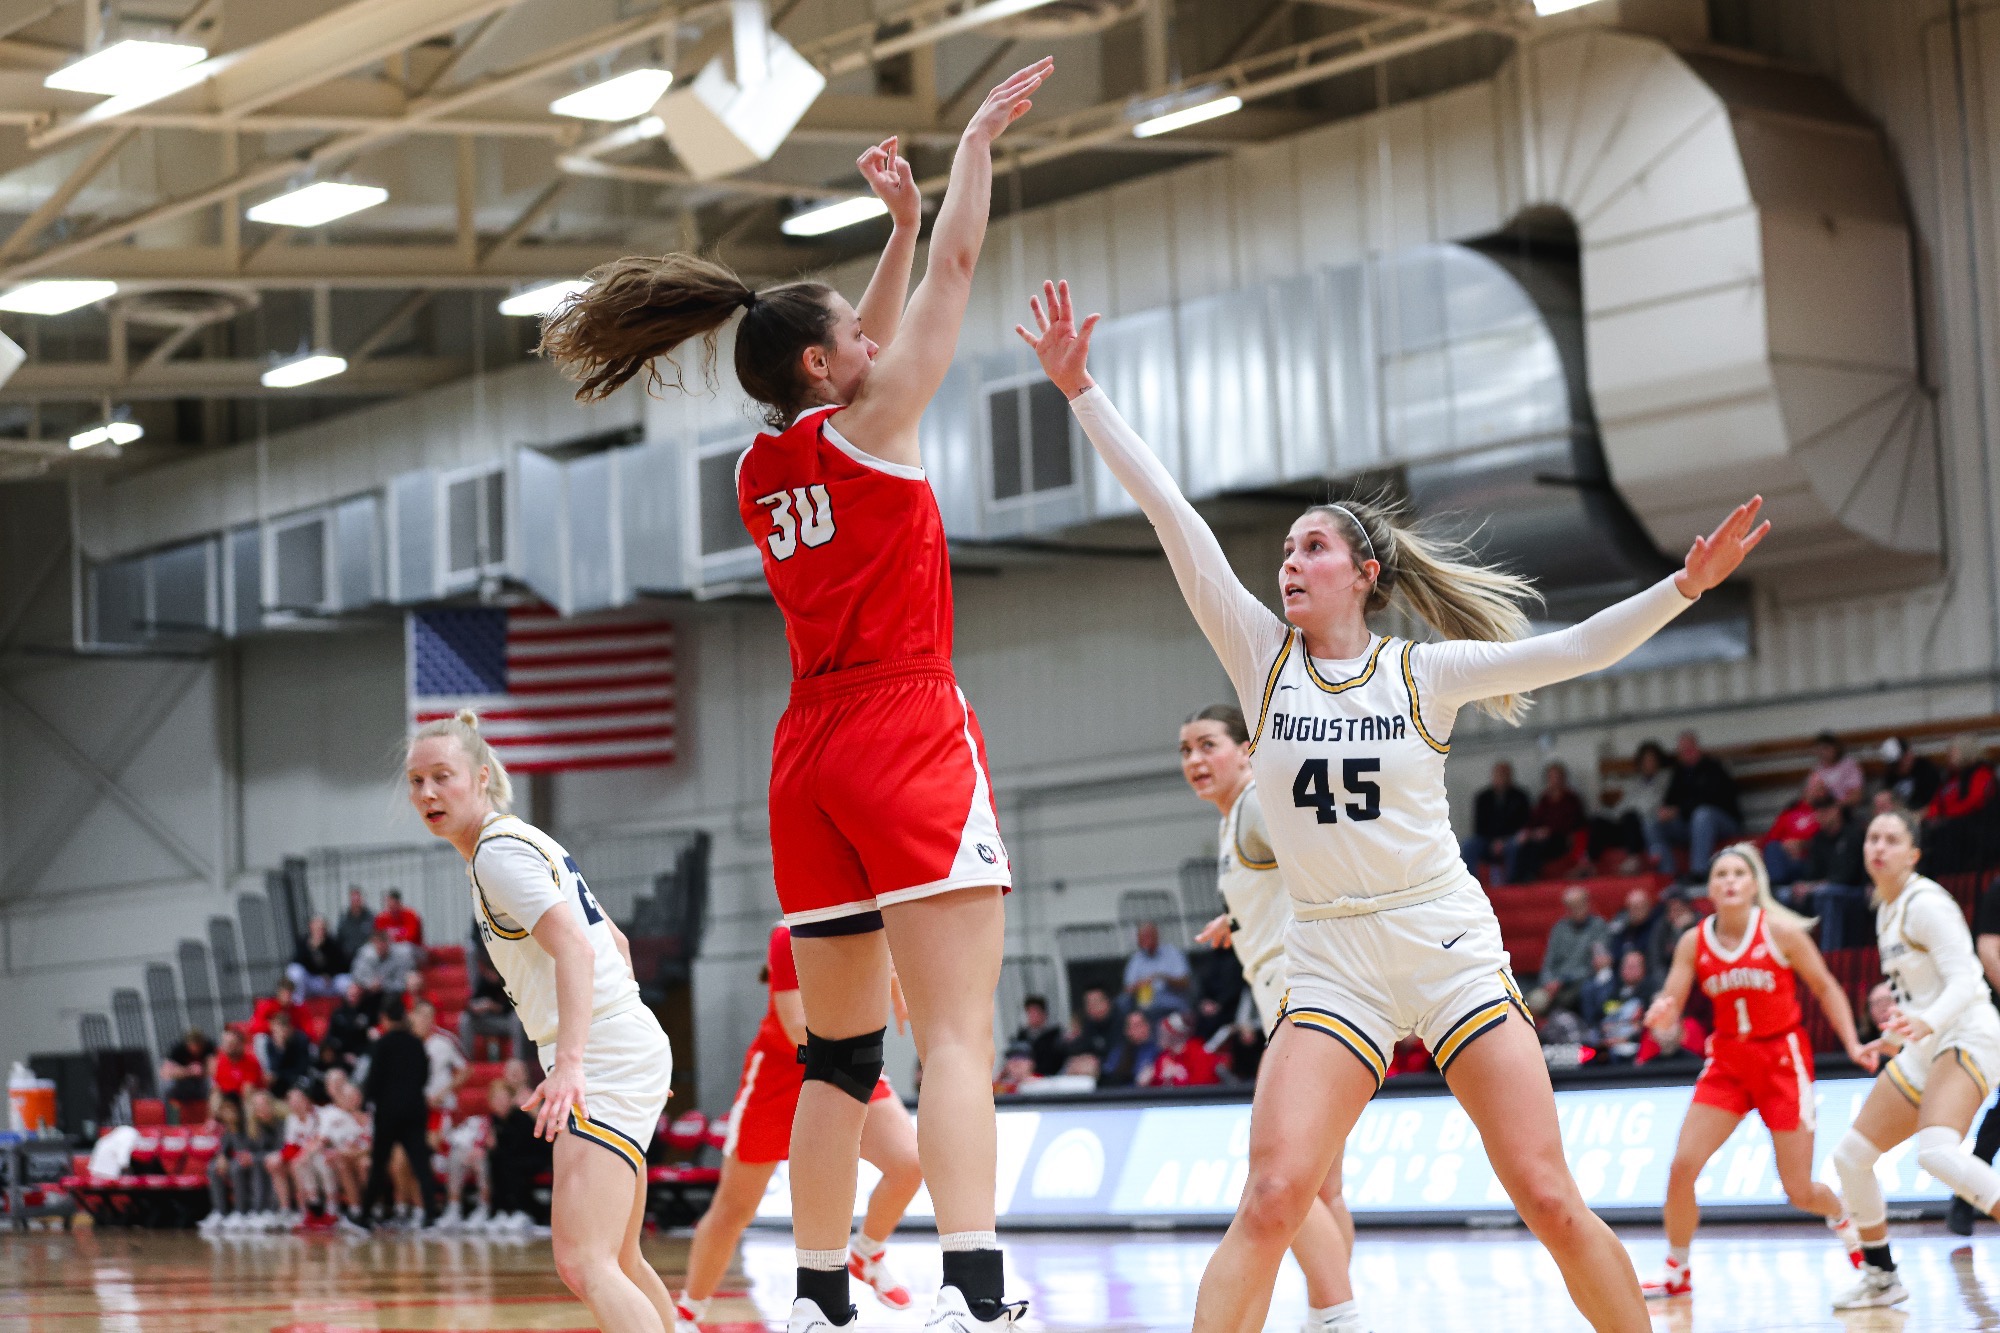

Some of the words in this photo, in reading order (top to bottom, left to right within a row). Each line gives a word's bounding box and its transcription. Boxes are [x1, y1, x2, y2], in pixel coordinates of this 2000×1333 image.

[1272, 713, 1406, 742] AUGUSTANA
[1293, 757, 1381, 824] 45
[1734, 998, 1752, 1034] 1
[1437, 1100, 1656, 1147] BING
[1142, 1152, 1464, 1204] AMA'S
